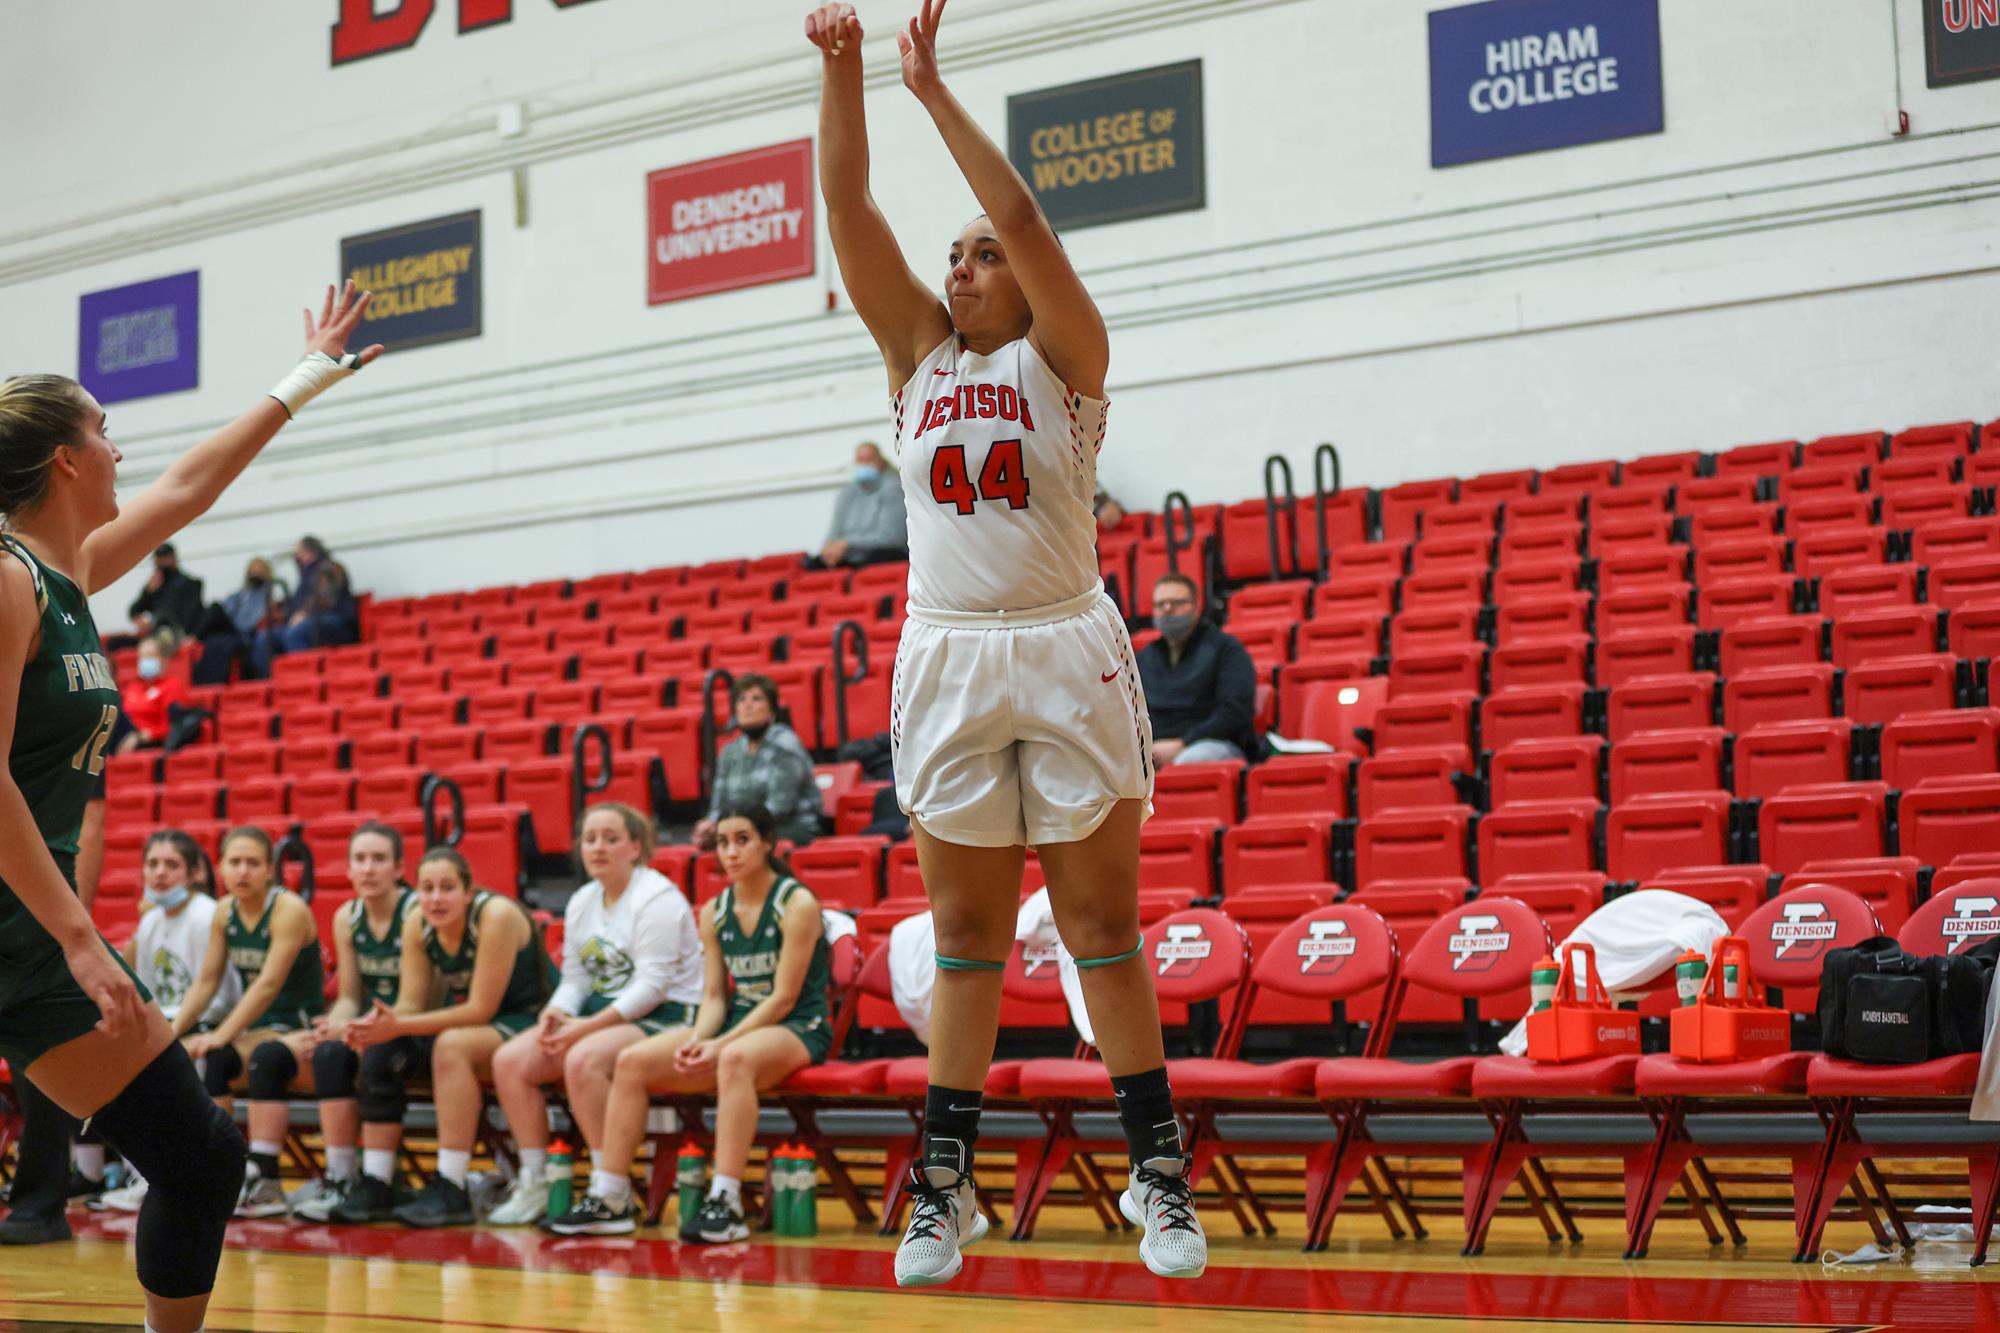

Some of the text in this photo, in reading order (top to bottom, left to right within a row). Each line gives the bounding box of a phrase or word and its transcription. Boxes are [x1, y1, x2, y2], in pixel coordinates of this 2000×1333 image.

[1485, 24, 1600, 76] HIRAM
[1468, 57, 1619, 114] COLLEGE
[1030, 107, 1177, 159] COLLEGE OF
[1031, 138, 1176, 193] WOOSTER
[671, 179, 786, 231] DENISON
[656, 207, 803, 265] UNIVERSITY
[351, 245, 473, 293] ALLEGHENY
[364, 276, 458, 321] COLLEGE
[929, 438, 1031, 516] 44
[71, 704, 119, 777] 12
[1159, 944, 1208, 956] DENISON
[1302, 941, 1353, 953] DENISON
[1453, 936, 1507, 950] DENISON
[1775, 924, 1834, 937] DENISON
[1945, 919, 2000, 932] DENISO
[1862, 1010, 1910, 1025] WOMEN'S BASKETBALL
